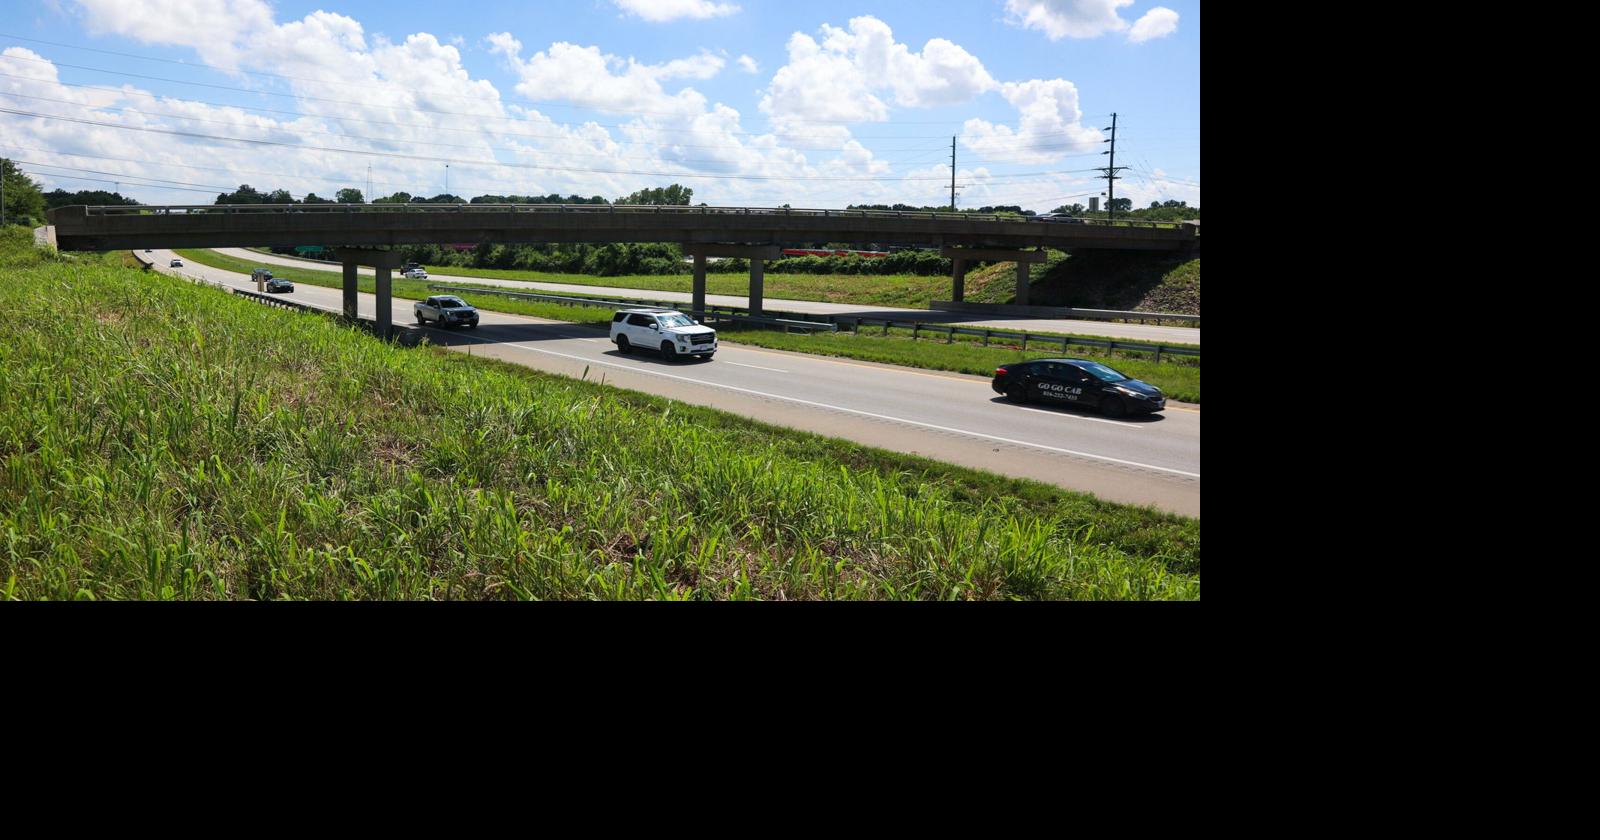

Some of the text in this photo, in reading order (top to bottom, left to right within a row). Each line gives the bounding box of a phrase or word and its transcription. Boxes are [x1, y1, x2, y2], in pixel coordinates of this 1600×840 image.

[1038, 382, 1082, 395] GO GO CAB
